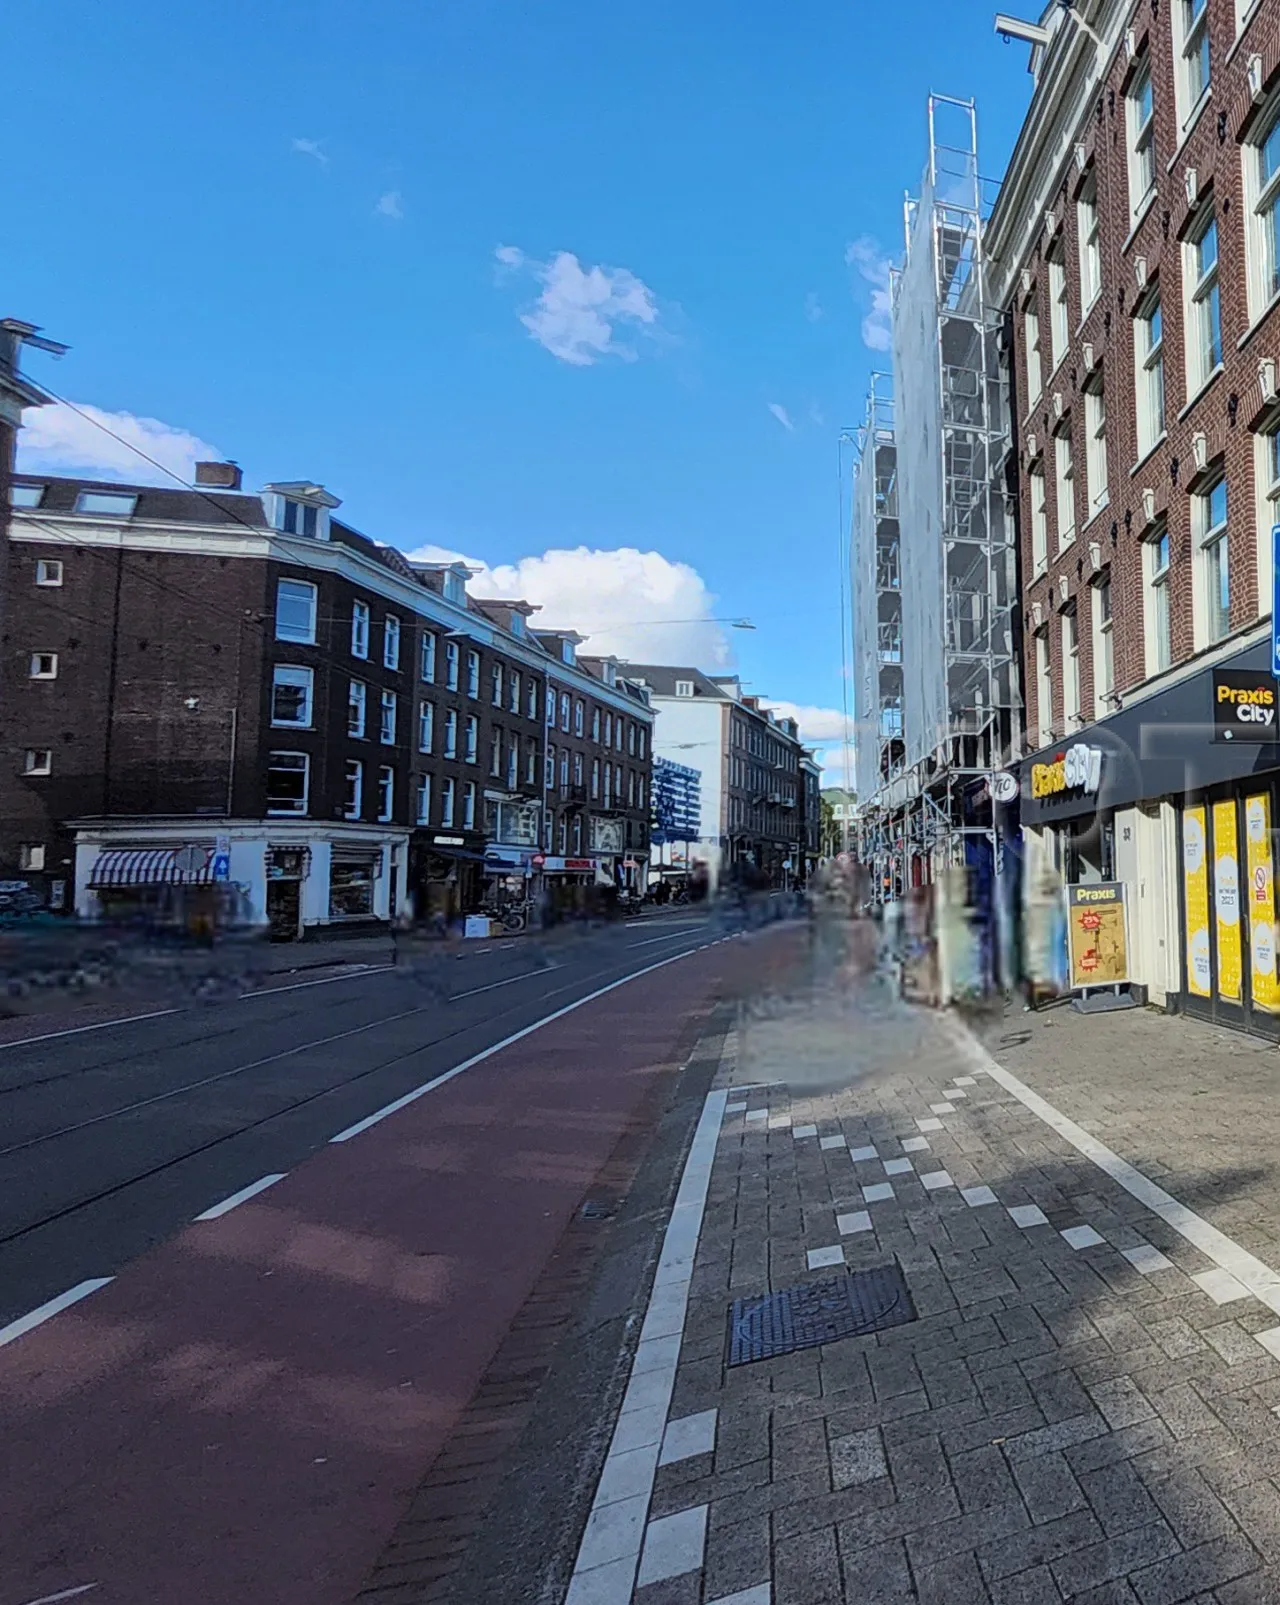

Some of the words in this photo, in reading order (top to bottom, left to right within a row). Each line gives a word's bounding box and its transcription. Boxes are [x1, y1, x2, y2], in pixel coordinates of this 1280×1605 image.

[1217, 685, 1275, 705] Praxis
[1236, 703, 1275, 726] City
[1077, 888, 1116, 901] Praxis
